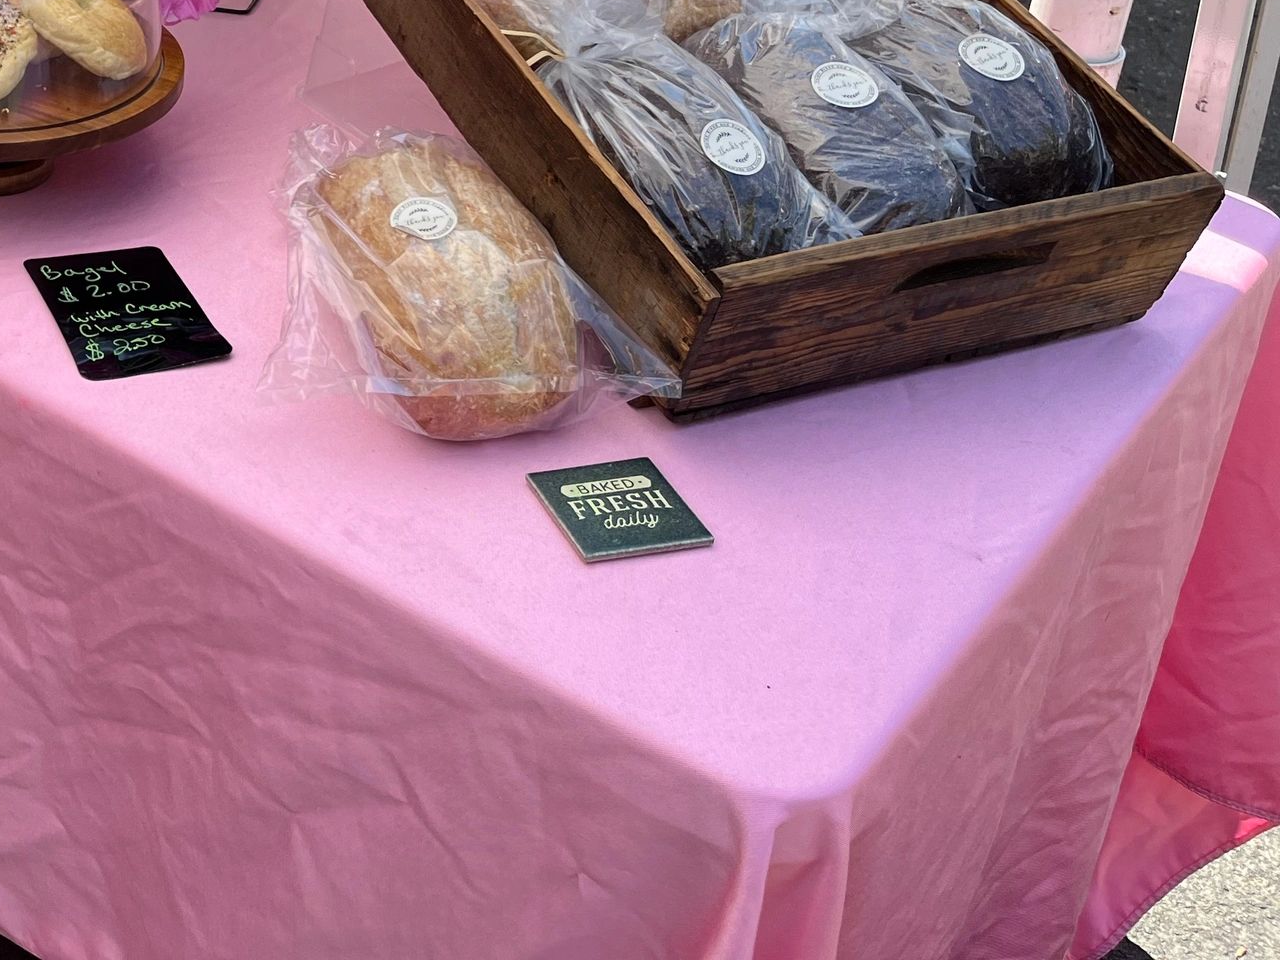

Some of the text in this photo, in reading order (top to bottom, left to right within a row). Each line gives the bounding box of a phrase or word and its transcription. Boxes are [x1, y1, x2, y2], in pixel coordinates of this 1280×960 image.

[40, 260, 127, 282] Bagel
[125, 300, 192, 315] Cream
[78, 317, 173, 338] Cheese
[575, 478, 635, 495] BAKED
[567, 489, 673, 521] FRESH
[604, 511, 659, 530] daily
